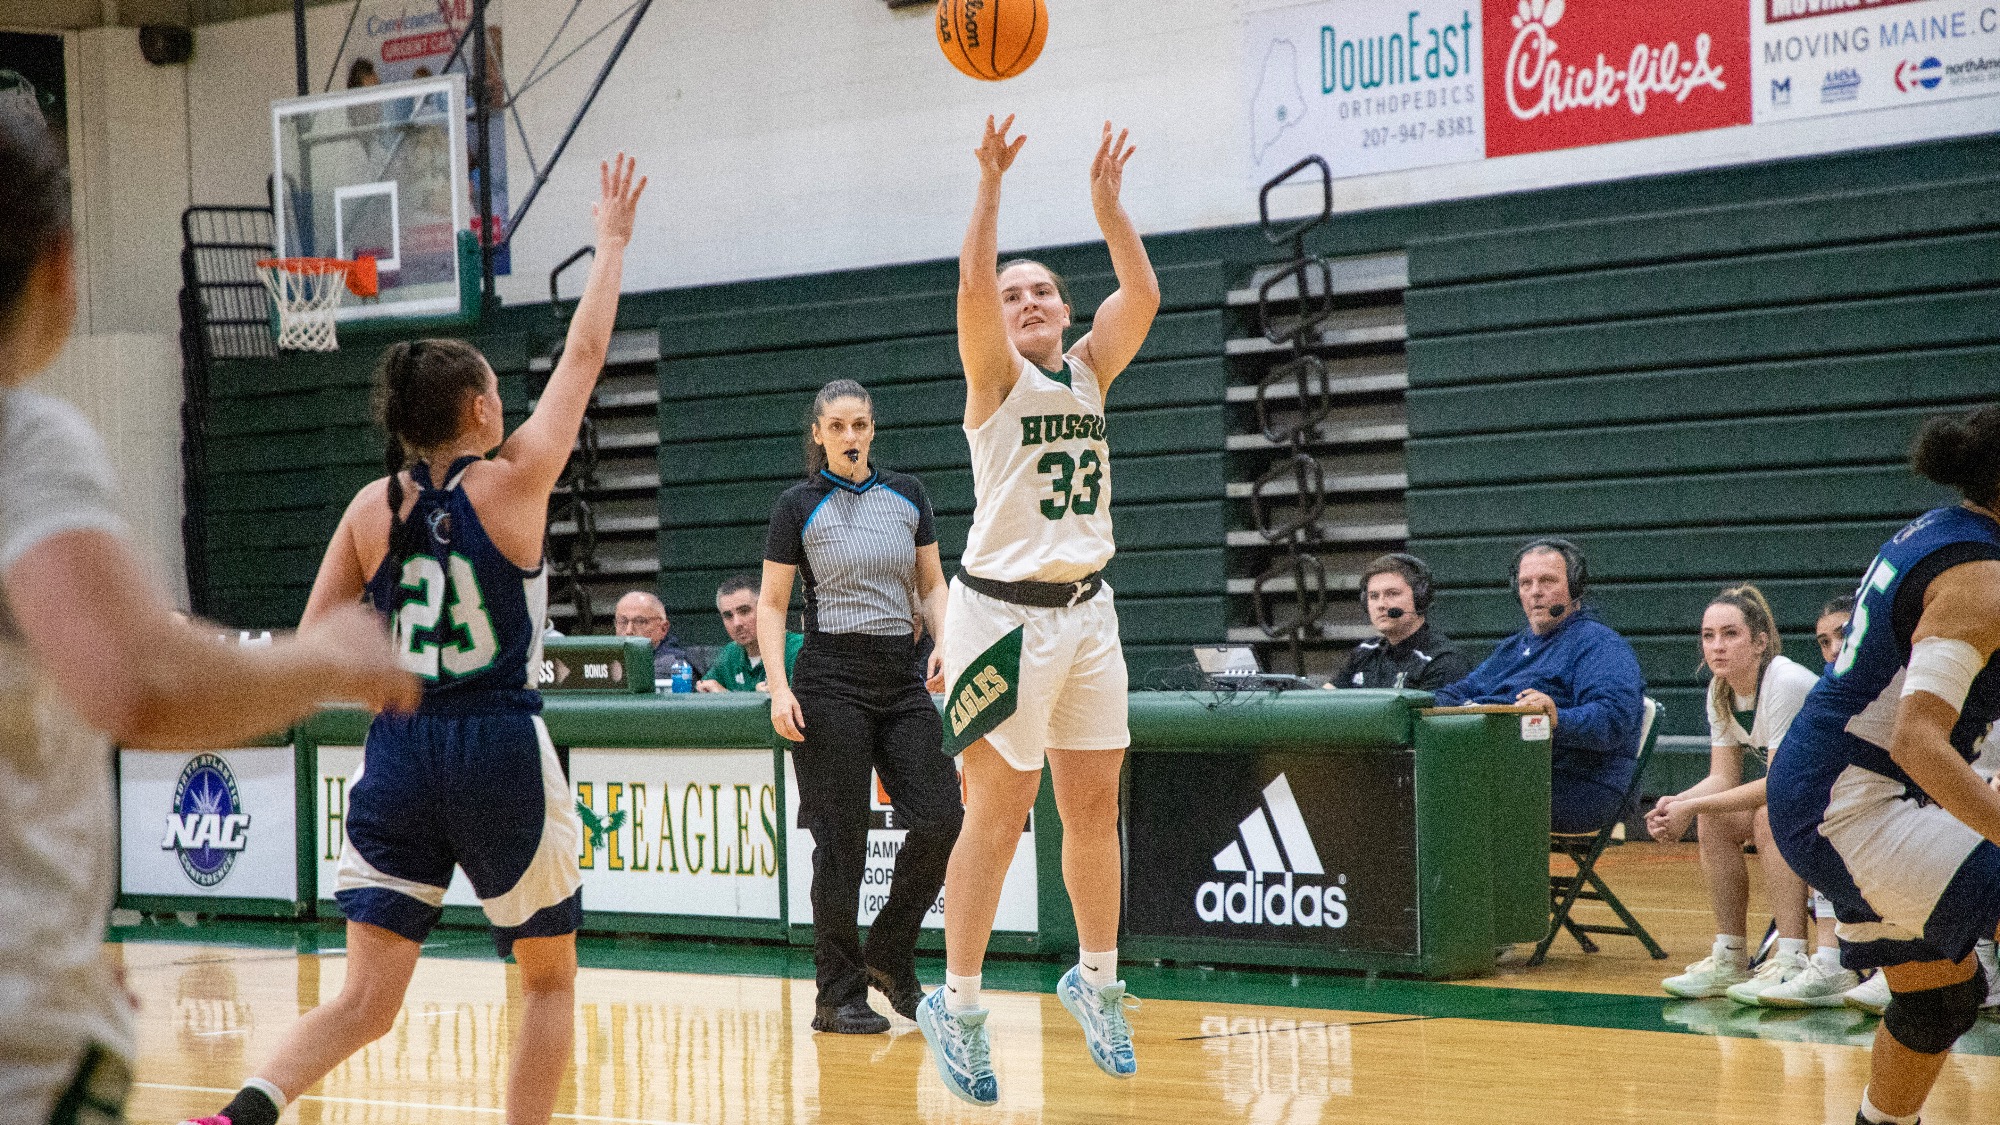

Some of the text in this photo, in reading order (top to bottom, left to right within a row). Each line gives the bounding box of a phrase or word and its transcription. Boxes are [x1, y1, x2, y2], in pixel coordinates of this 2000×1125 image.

[1320, 10, 1472, 95] DownEast
[1504, 20, 1727, 120] Chick-fil-A
[1764, 26, 1870, 64] MOVING
[1339, 84, 1475, 119] ORTHOPEDICS
[1362, 116, 1476, 148] 207-947-8381
[1037, 449, 1103, 521] 33
[392, 551, 501, 681] 23
[583, 663, 609, 679] BONUS
[950, 664, 1009, 737] EAGLES
[201, 755, 240, 806] ATLANTIC
[161, 812, 250, 851] NAC
[629, 782, 778, 878] EAGLES
[179, 852, 235, 886] CONFERENCE
[1195, 870, 1349, 929] adidas
